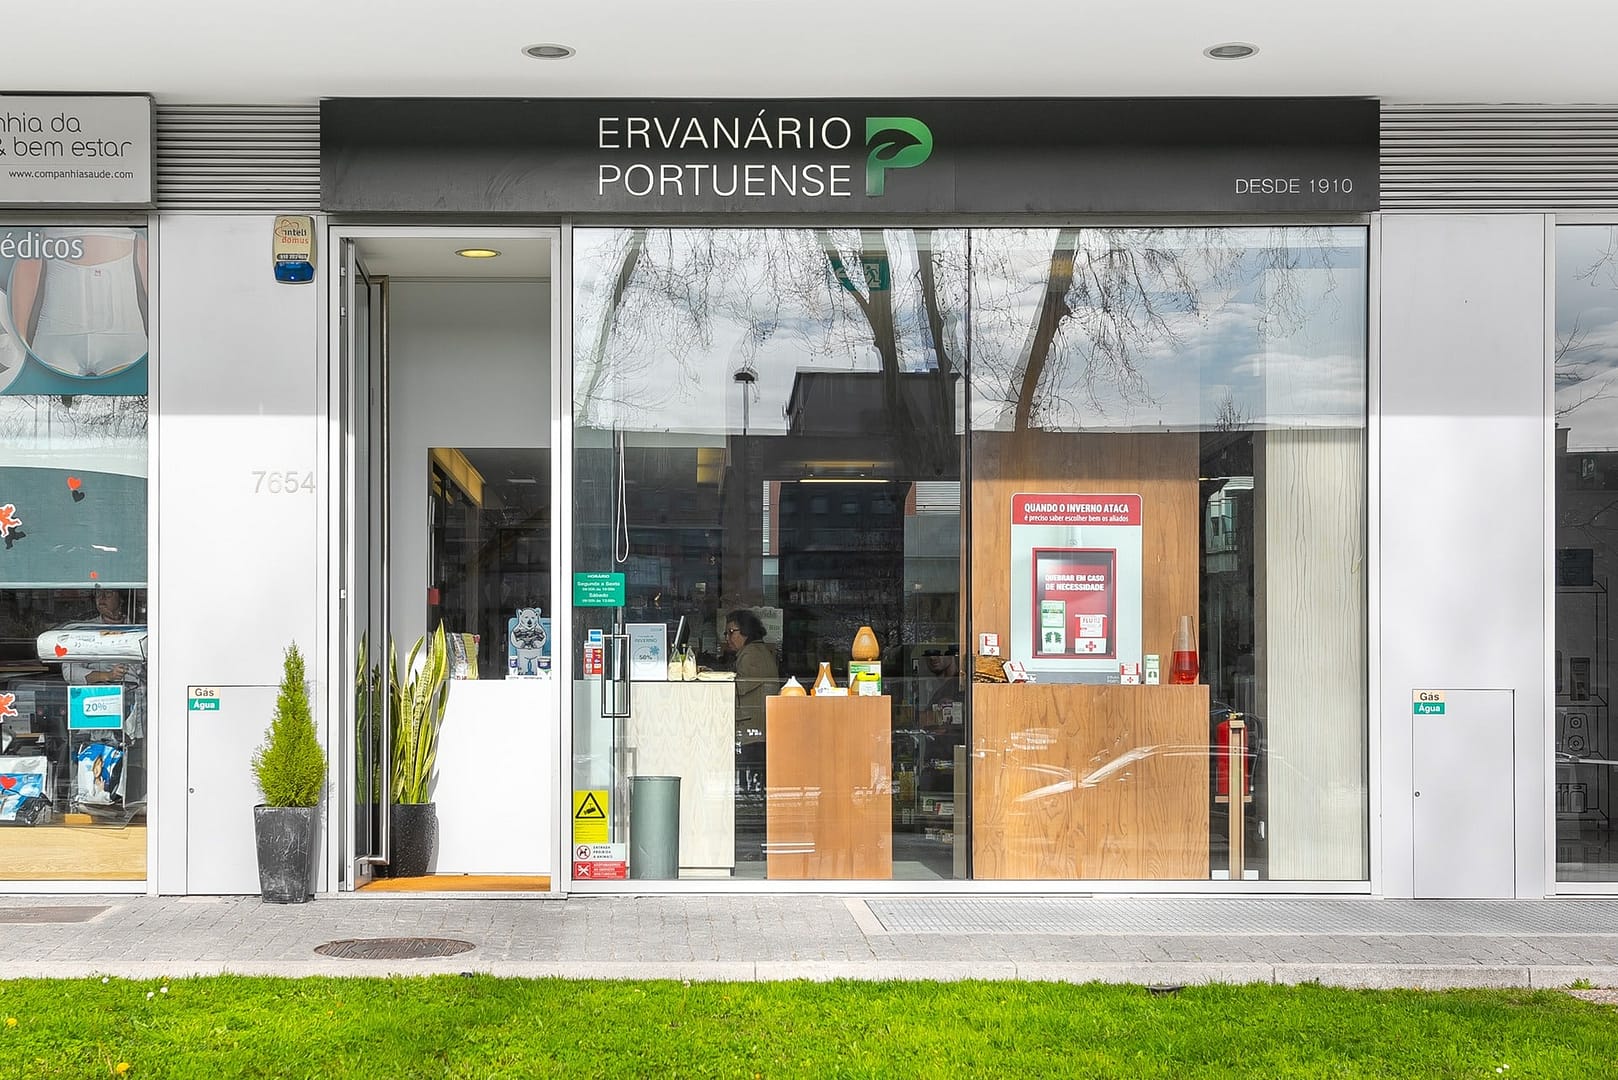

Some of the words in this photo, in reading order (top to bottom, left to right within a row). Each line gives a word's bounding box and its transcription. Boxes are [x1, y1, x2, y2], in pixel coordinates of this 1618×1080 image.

[51, 112, 81, 132] da
[597, 109, 851, 150] ERVANÁRIO
[13, 136, 63, 156] bem
[71, 138, 132, 157] estar
[8, 170, 134, 180] www.companhiasaude.com
[597, 164, 851, 197] PORTUENSE
[1235, 178, 1300, 194] DESDE
[1309, 178, 1353, 194] 1910
[0, 231, 84, 259] édicos
[281, 236, 309, 244] domus
[251, 470, 316, 494] 7654
[1024, 503, 1058, 513] QUANDO
[1059, 503, 1066, 513] O
[1067, 503, 1102, 513] INVERNO
[1103, 503, 1129, 513] ATACA
[1028, 515, 1049, 523] preciso
[1045, 574, 1075, 582] QUEBRAR
[1076, 574, 1087, 582] EM
[1087, 574, 1105, 582] CASO
[1045, 583, 1055, 591] DE
[1056, 583, 1105, 591] NECESSIDADE
[195, 688, 215, 697] Gás
[1420, 692, 1440, 701] Gás
[85, 702, 108, 712] 20%
[193, 698, 216, 711] Água
[1419, 702, 1441, 713] Água
